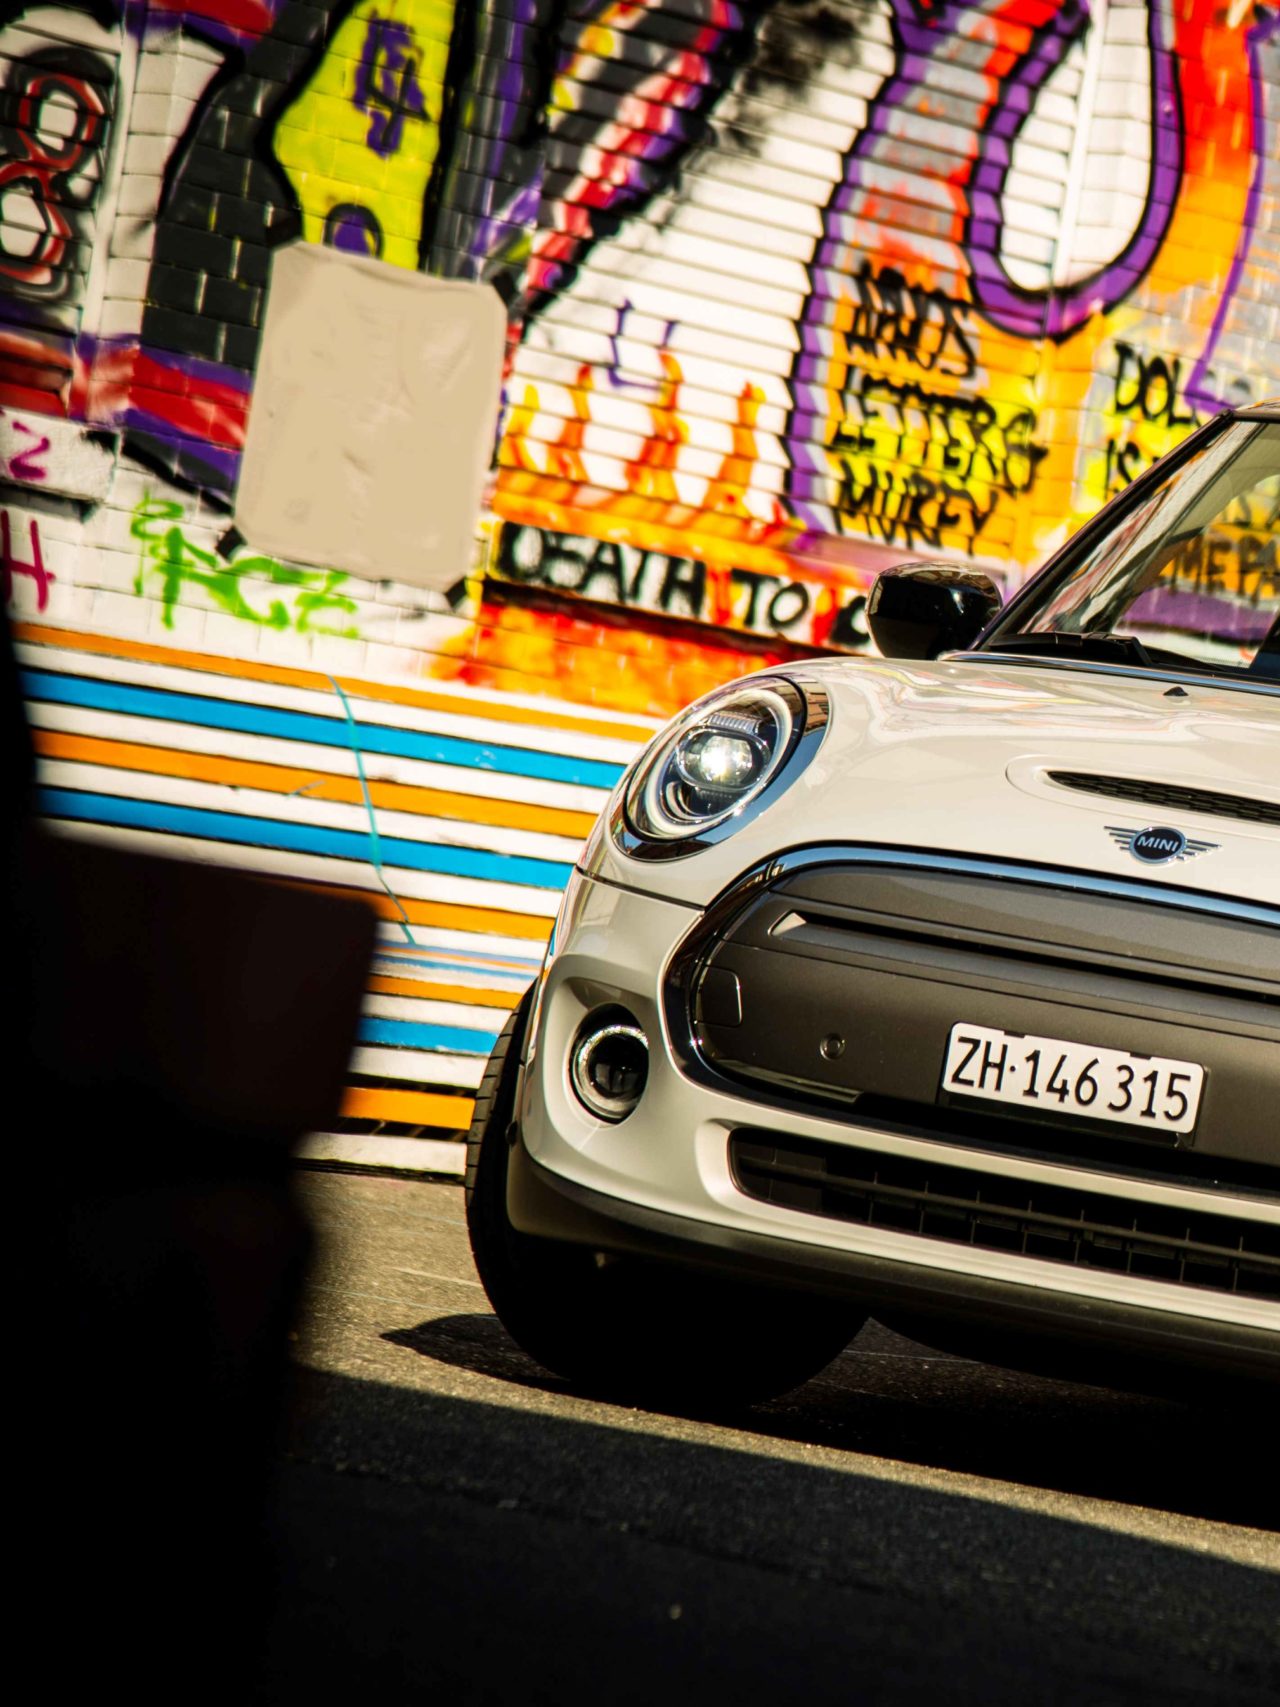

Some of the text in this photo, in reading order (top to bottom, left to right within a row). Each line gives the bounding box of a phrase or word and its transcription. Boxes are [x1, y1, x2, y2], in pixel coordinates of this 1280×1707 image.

[500, 520, 706, 616] DEATH
[731, 566, 809, 632] TO
[1137, 836, 1179, 852] MINI
